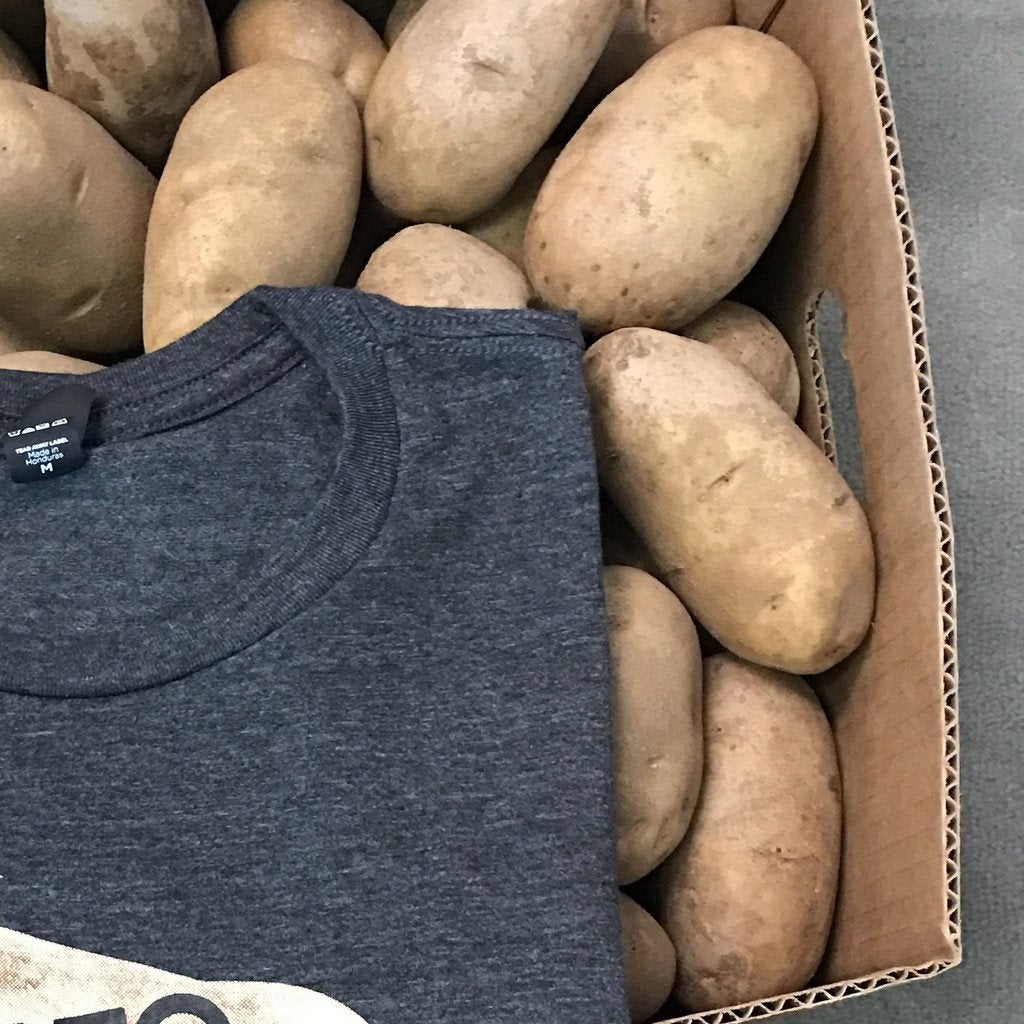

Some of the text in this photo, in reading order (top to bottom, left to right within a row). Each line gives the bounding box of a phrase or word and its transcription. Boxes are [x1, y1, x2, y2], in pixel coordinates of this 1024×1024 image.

[27, 446, 59, 458] Made in
[25, 452, 64, 466] Honduras
[40, 462, 53, 474] M
